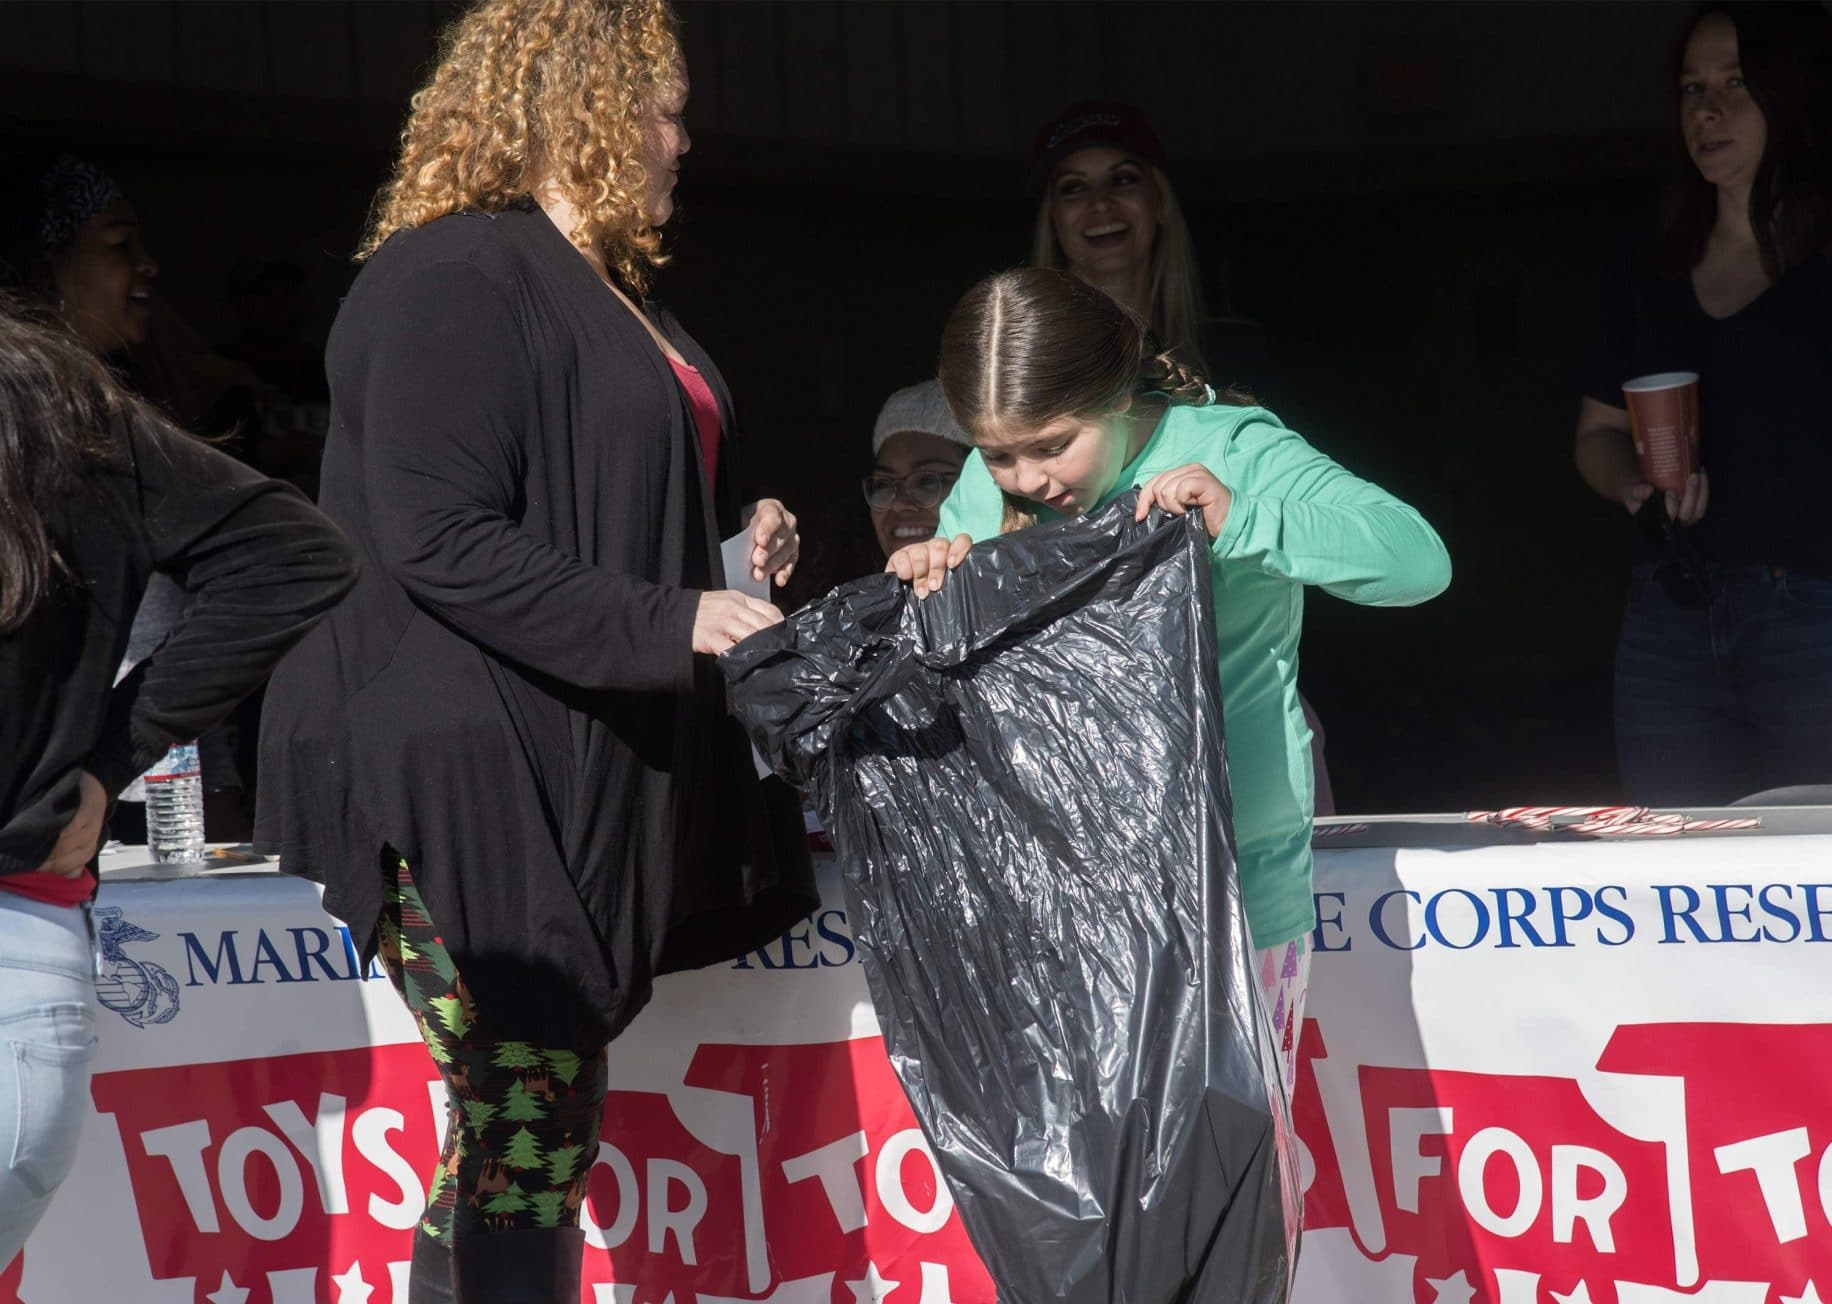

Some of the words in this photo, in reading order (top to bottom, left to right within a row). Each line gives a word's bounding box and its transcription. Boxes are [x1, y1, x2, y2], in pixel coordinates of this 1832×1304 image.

[176, 926, 386, 986] MARI
[1368, 886, 1635, 950] CORPS
[140, 1092, 426, 1241] TOYS
[1388, 1107, 1628, 1254] FOR
[1713, 1126, 1832, 1245] T
